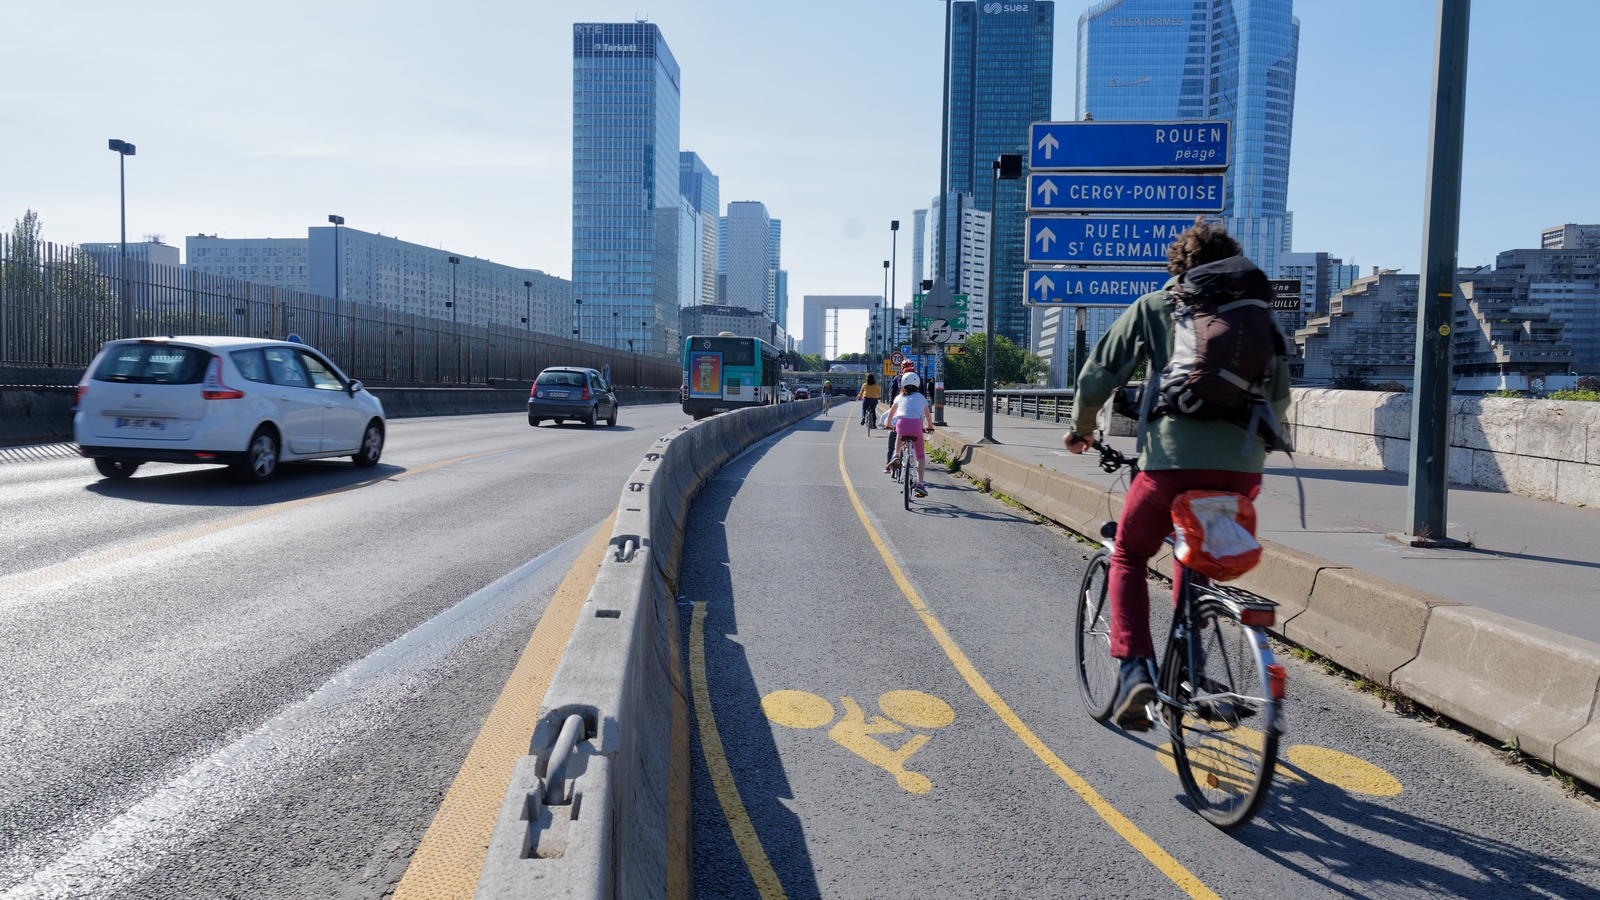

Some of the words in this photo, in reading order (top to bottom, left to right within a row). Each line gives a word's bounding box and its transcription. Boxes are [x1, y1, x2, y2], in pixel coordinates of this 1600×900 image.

[1003, 4, 1029, 12] suez
[1110, 17, 1140, 27] EULER
[1142, 17, 1184, 27] HERMES
[574, 24, 603, 34] RTE
[603, 43, 638, 52] Tarkett
[1108, 78, 1120, 87] EY
[1155, 128, 1221, 144] ROUEN
[1174, 146, 1216, 162] péage
[1069, 184, 1217, 200] CERGY-PONTOISE
[1066, 280, 1084, 295] LA
[1089, 280, 1159, 295] GARENNE
[1269, 300, 1299, 308] EUILLY
[893, 355, 902, 363] 70
